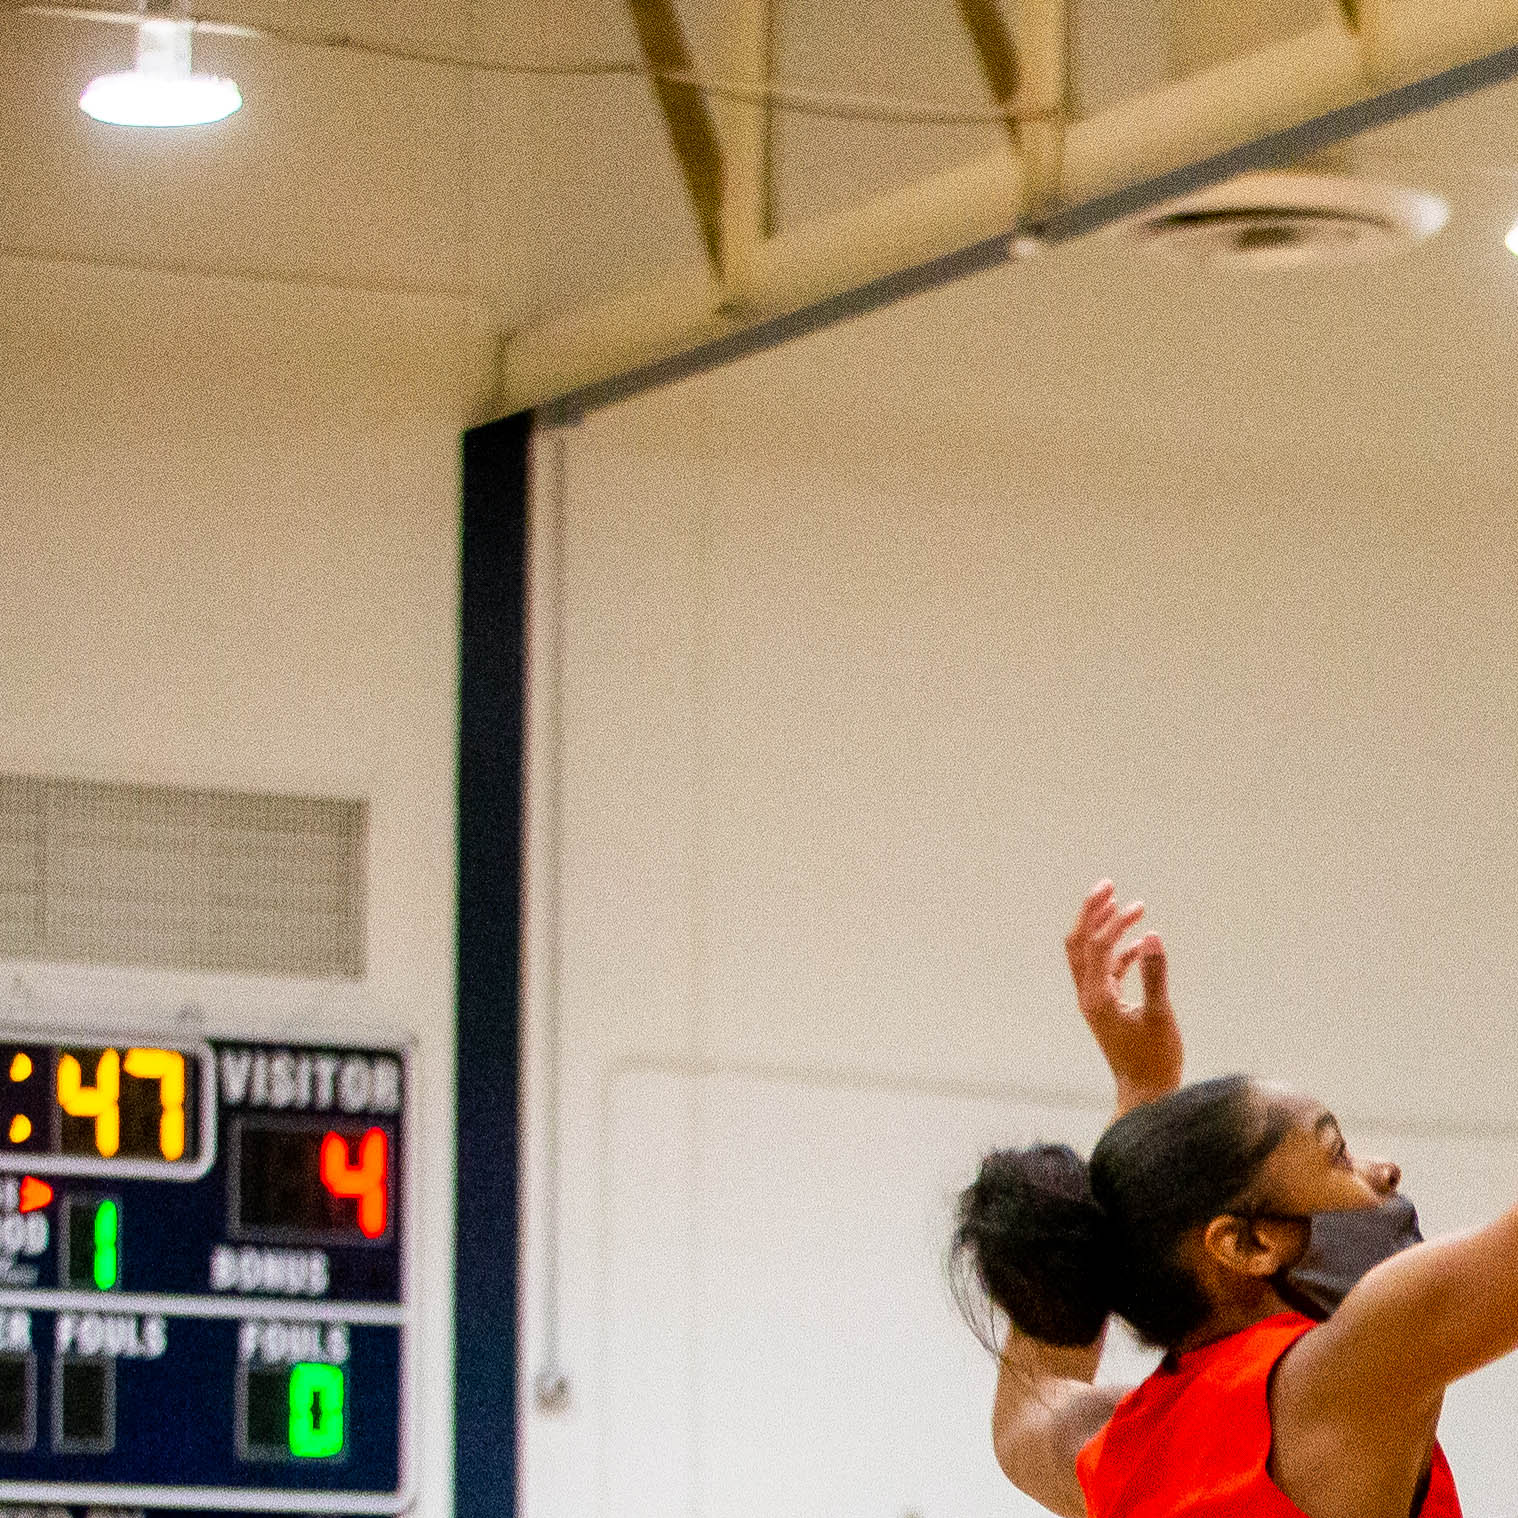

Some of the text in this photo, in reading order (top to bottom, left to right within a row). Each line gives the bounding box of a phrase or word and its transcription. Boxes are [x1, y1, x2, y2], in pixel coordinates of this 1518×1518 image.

[221, 1049, 401, 1114] VISITOR
[319, 1126, 389, 1240] 4
[93, 1199, 119, 1291] 1
[209, 1244, 330, 1297] BONUS
[55, 1311, 169, 1361] FOULS
[238, 1320, 350, 1365] FOULS
[288, 1361, 345, 1458] 0
